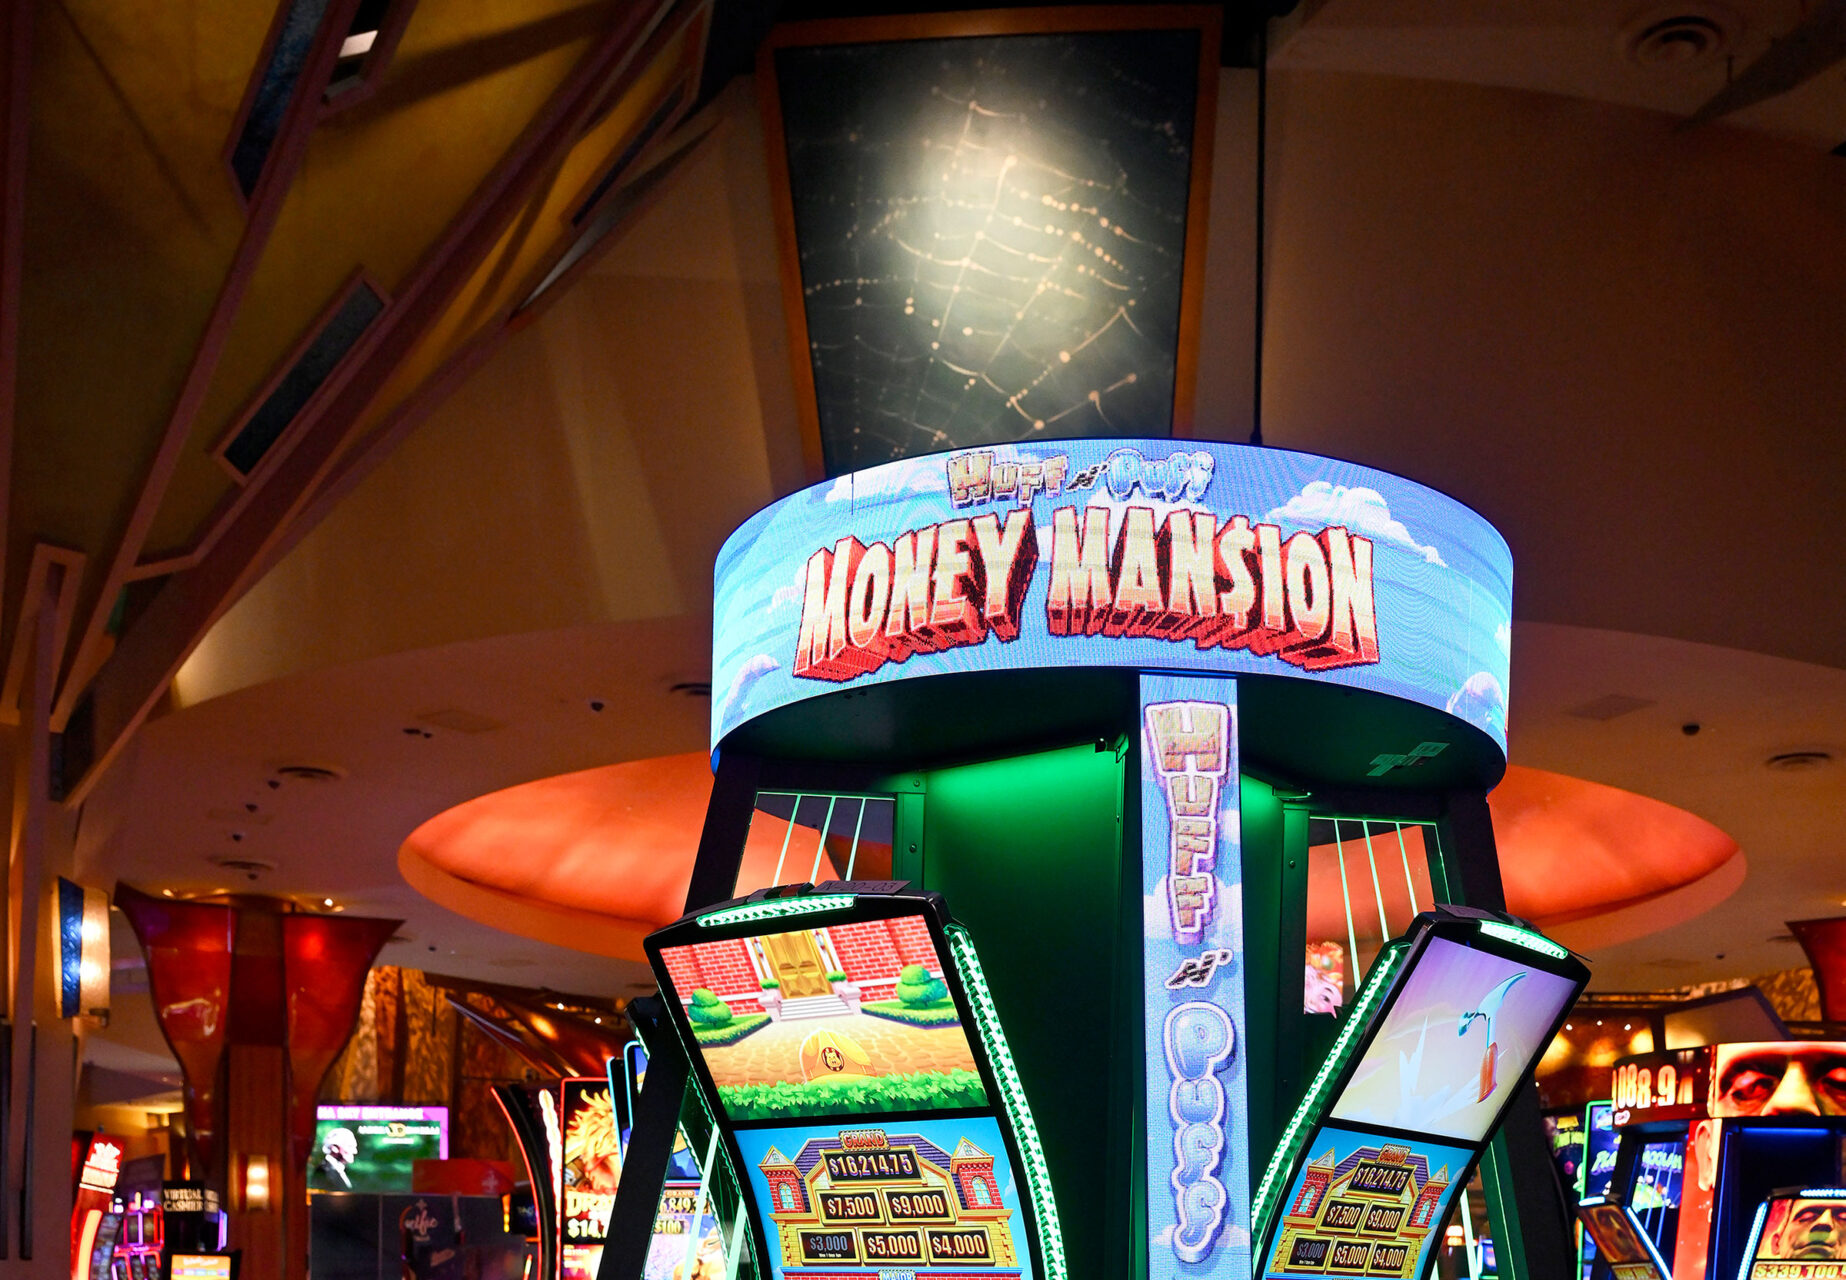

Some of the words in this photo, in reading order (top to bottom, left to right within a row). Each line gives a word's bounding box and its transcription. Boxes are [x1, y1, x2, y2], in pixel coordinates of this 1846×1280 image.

[794, 509, 1038, 681] MONEY
[843, 1132, 884, 1149] GRAND
[828, 1153, 914, 1177] $16,214.75
[1353, 1166, 1408, 1190] $16,214.75
[827, 1195, 875, 1218] $7,500
[892, 1194, 945, 1217] $9,000
[1327, 1205, 1361, 1226] $7,500
[1367, 1208, 1401, 1229] $9,000
[809, 1235, 848, 1251] $3,000
[867, 1234, 919, 1257] $5,000
[934, 1234, 986, 1257] $4,000
[1334, 1244, 1367, 1266] $5,000
[1373, 1248, 1405, 1269] $4,000
